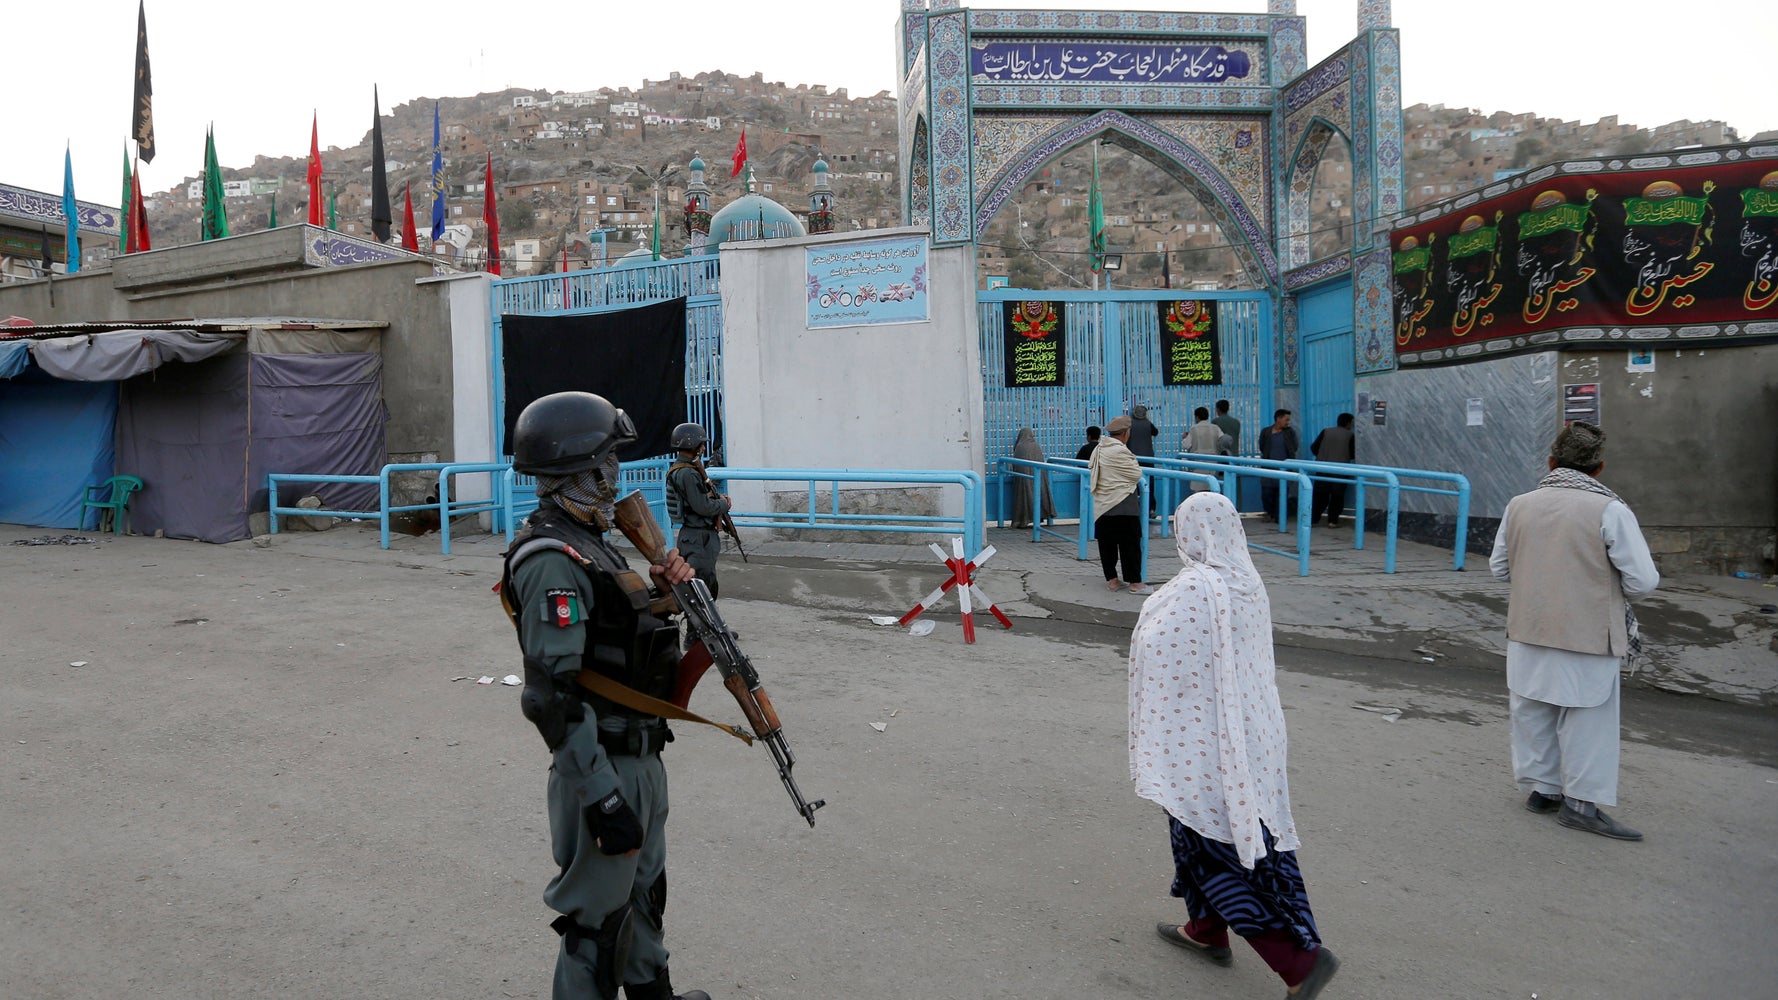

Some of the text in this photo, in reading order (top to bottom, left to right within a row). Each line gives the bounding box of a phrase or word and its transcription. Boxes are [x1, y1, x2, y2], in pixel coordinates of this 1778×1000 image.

[1028, 57, 1051, 79] بن
[1049, 47, 1074, 80] علی
[1067, 50, 1118, 79] حضرت
[1184, 47, 1228, 78] قدمگاه
[1522, 267, 1597, 324] حسین
[1626, 261, 1715, 317] حسین
[1396, 299, 1435, 346] حسین
[1451, 283, 1503, 337] حسین
